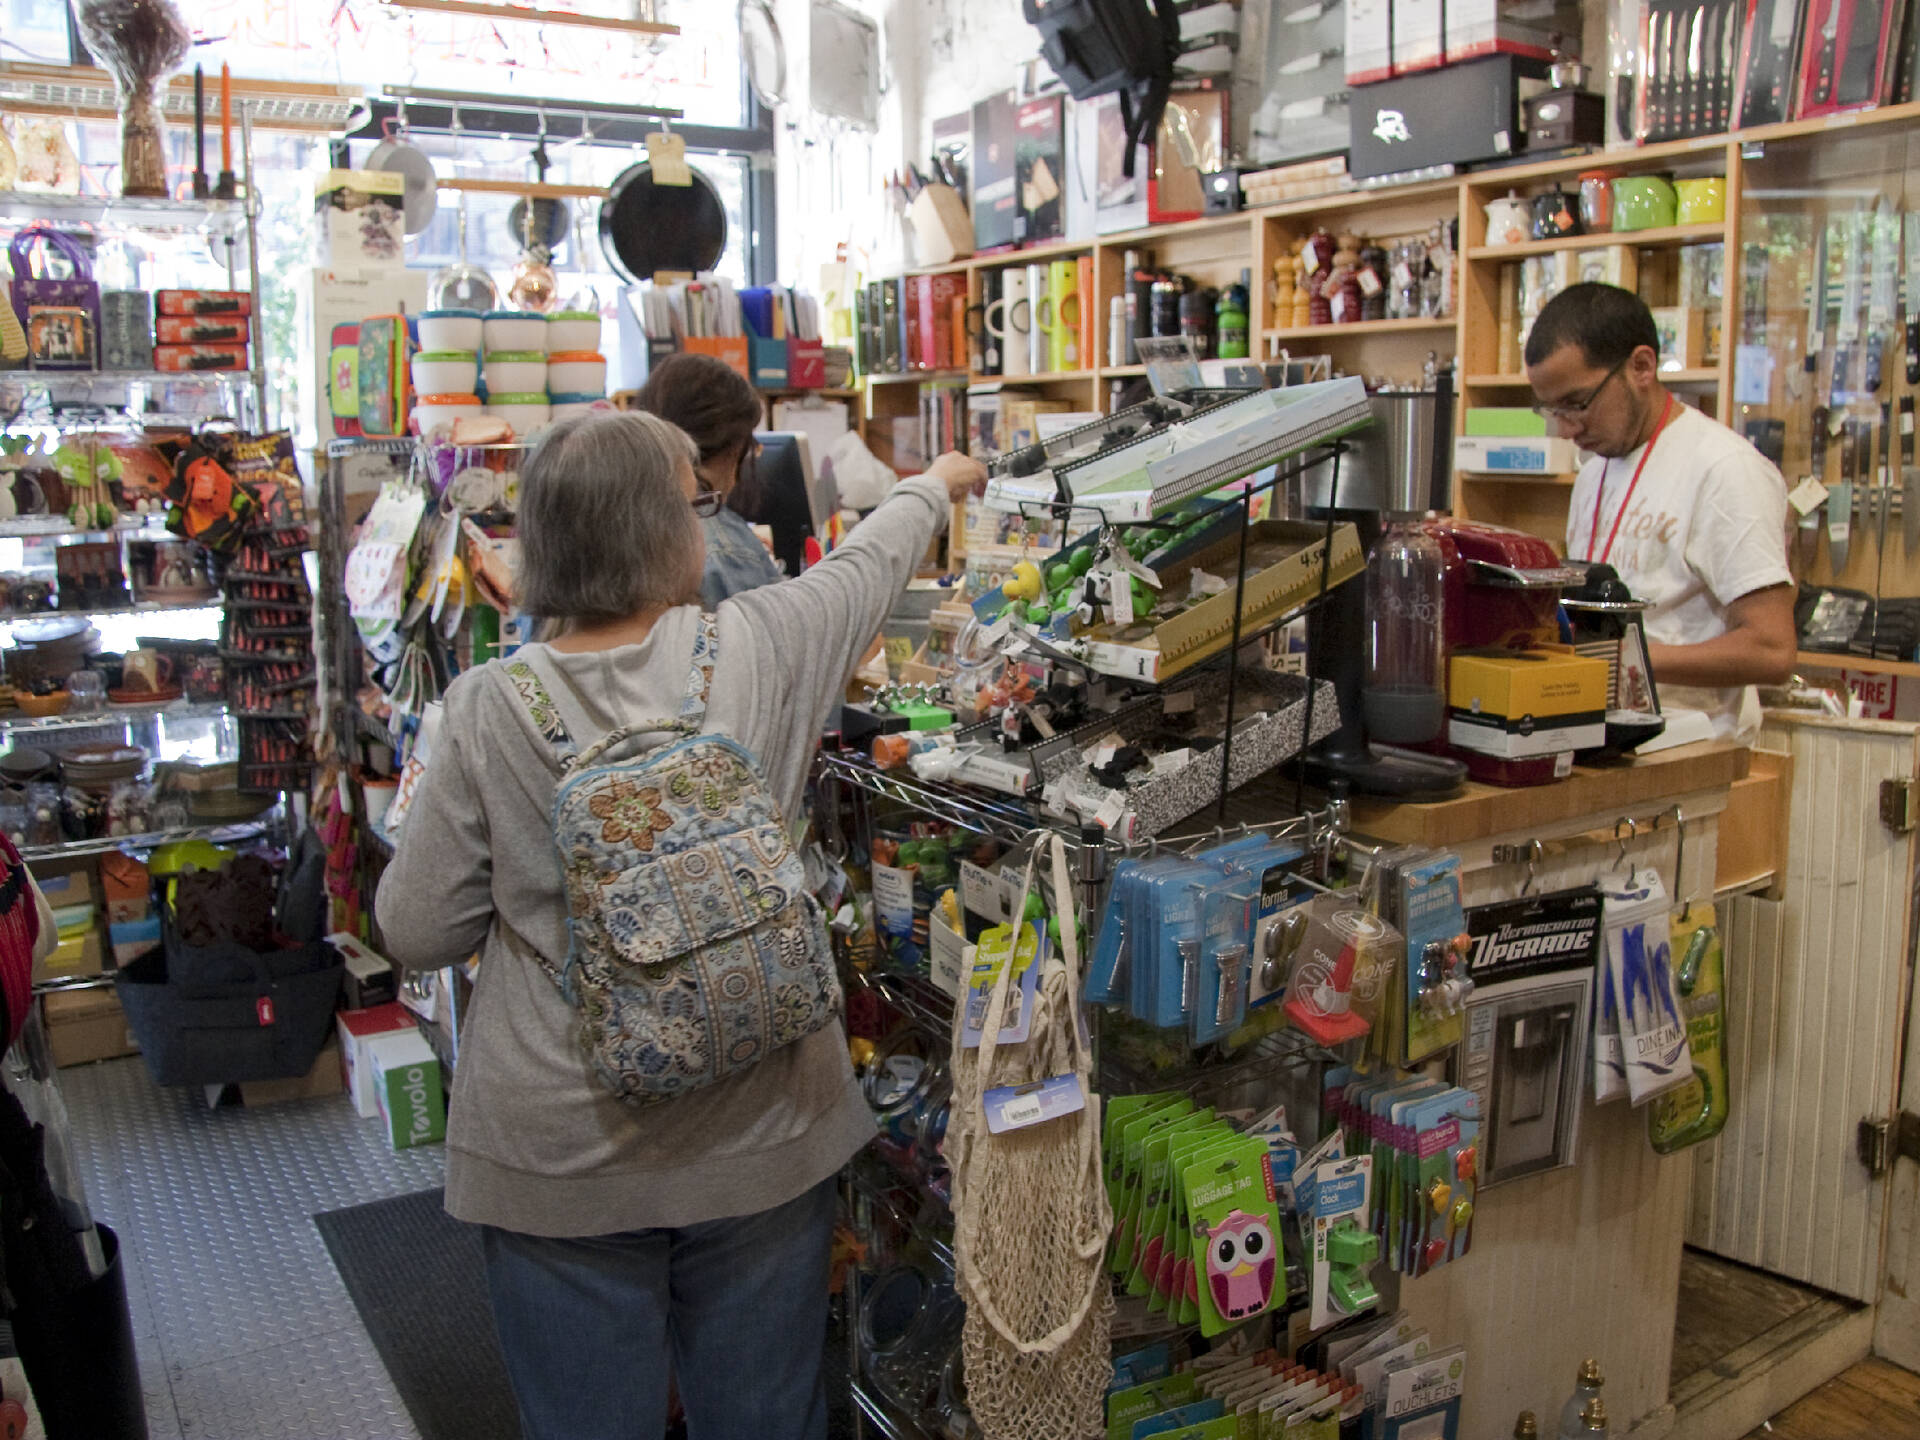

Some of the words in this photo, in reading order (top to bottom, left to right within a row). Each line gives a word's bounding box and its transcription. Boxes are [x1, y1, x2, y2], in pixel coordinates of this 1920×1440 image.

[1850, 678, 1887, 704] FIRE
[1262, 889, 1289, 909] forma
[1313, 948, 1337, 974] CONE
[1471, 930, 1595, 969] UPGRADE
[1352, 957, 1397, 984] CONE
[1636, 1030, 1664, 1055] DINE
[403, 1068, 431, 1145] Tovolo
[1192, 1183, 1234, 1208] LUGGAGE
[1235, 1175, 1252, 1193] TAG
[1320, 1193, 1339, 1205] Clock
[1392, 1382, 1458, 1415] OUCHLETS
